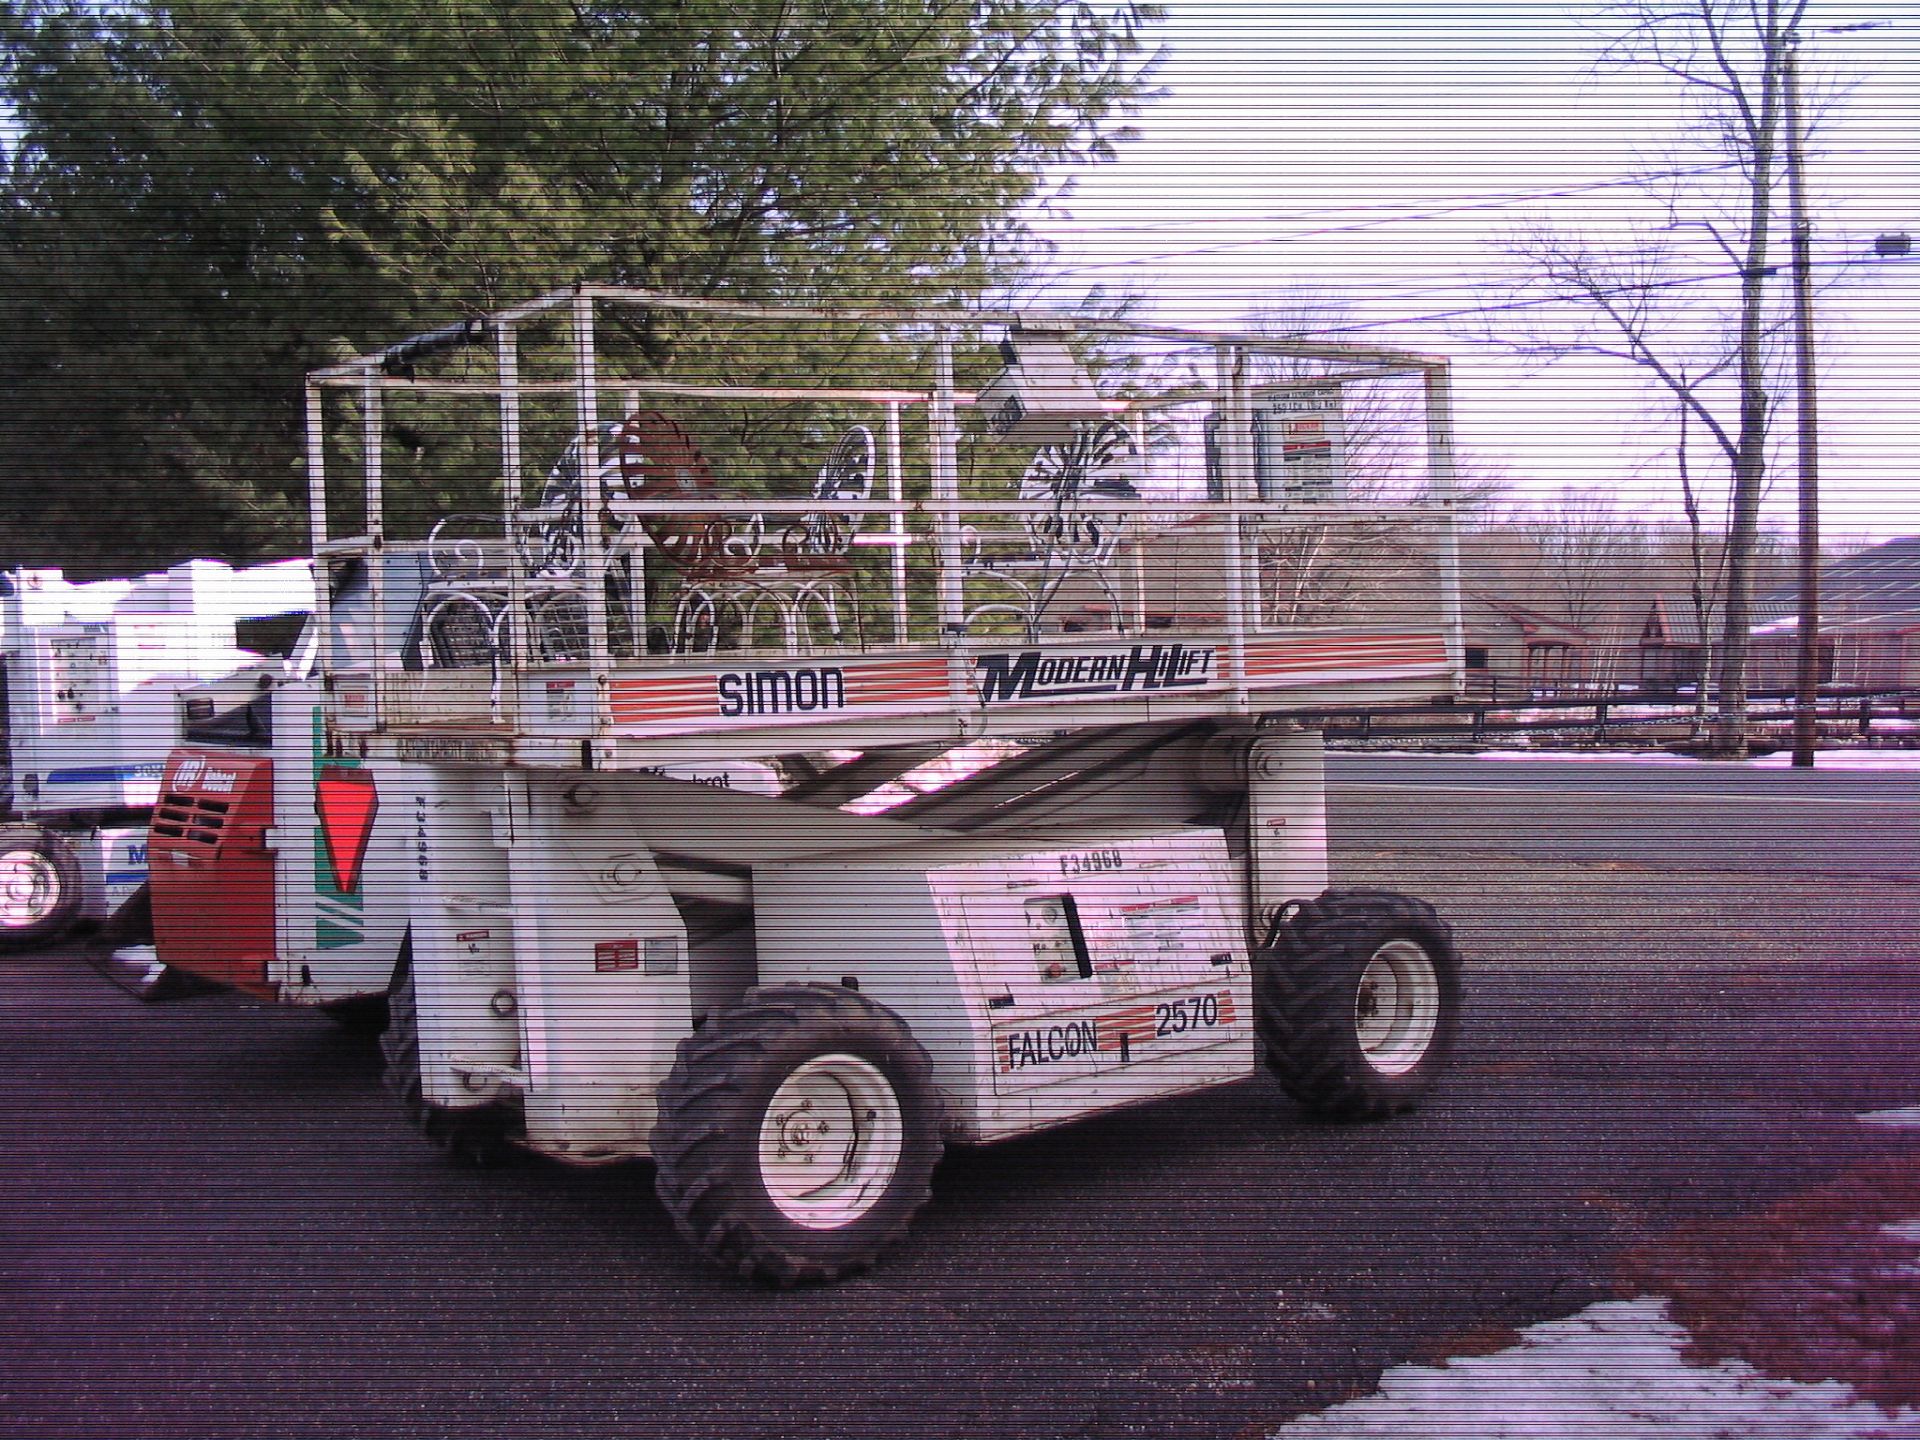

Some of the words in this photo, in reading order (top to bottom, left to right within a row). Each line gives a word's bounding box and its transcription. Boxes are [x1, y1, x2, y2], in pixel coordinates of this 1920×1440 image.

[718, 667, 845, 717] SIMON
[415, 796, 429, 881] F34968
[1060, 850, 1122, 877] F34968
[1007, 1020, 1098, 1071] FALCON
[1156, 993, 1218, 1038] 2570
